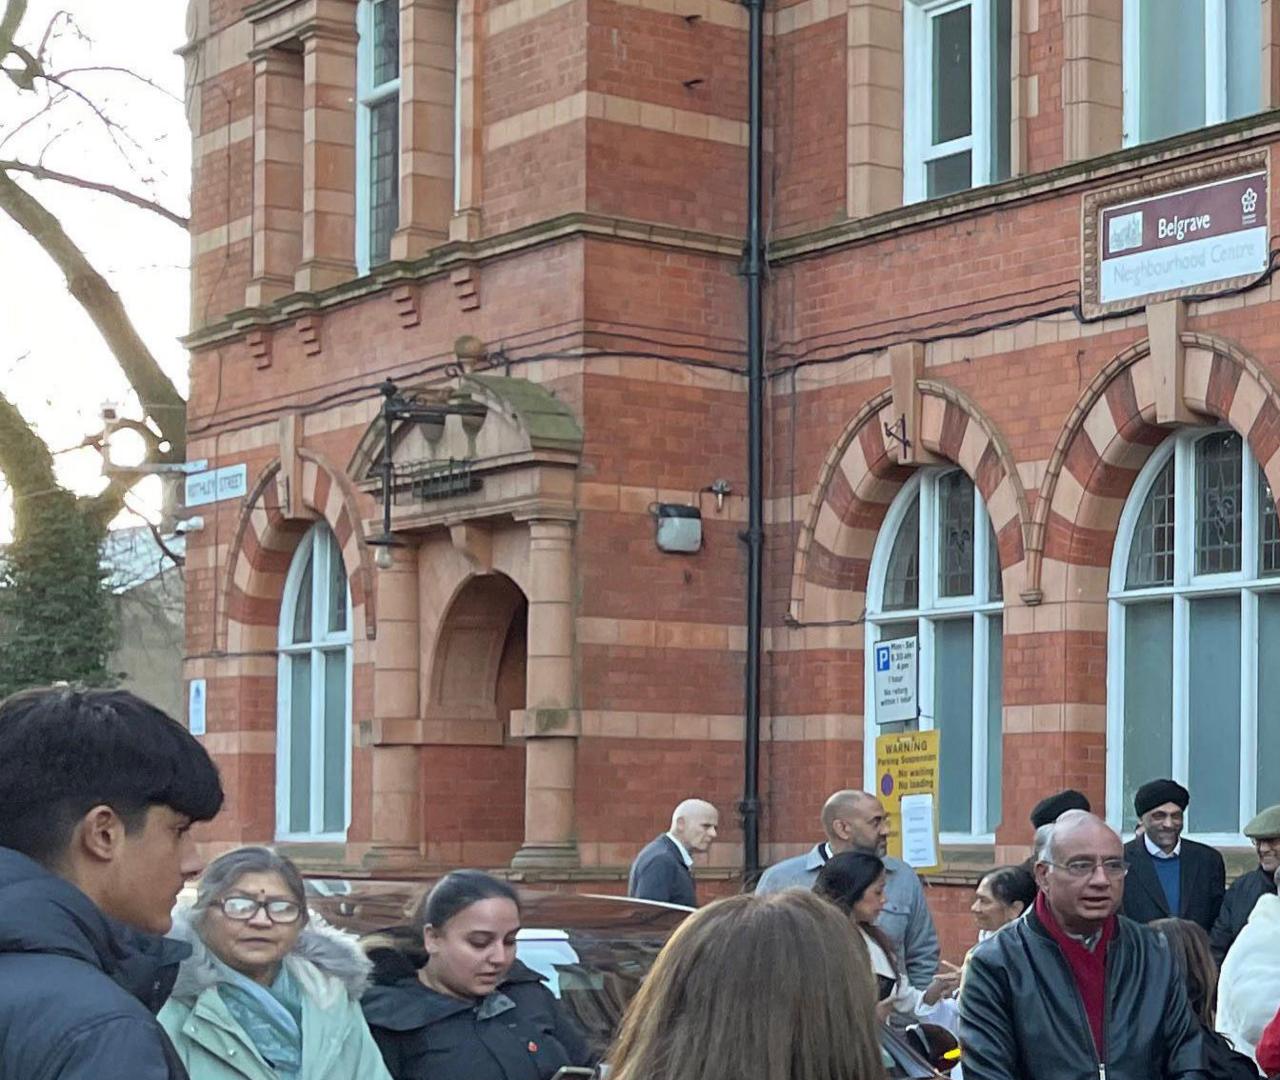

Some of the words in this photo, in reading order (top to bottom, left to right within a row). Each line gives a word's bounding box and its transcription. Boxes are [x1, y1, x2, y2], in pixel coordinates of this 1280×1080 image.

[1158, 214, 1211, 240] Belgrave
[1211, 243, 1255, 264] Centre
[885, 740, 928, 755] WARNING
[878, 757, 899, 767] Parking
[898, 769, 908, 778] No
[910, 768, 934, 778] waiting
[898, 781, 908, 790] No
[910, 778, 934, 789] loading
